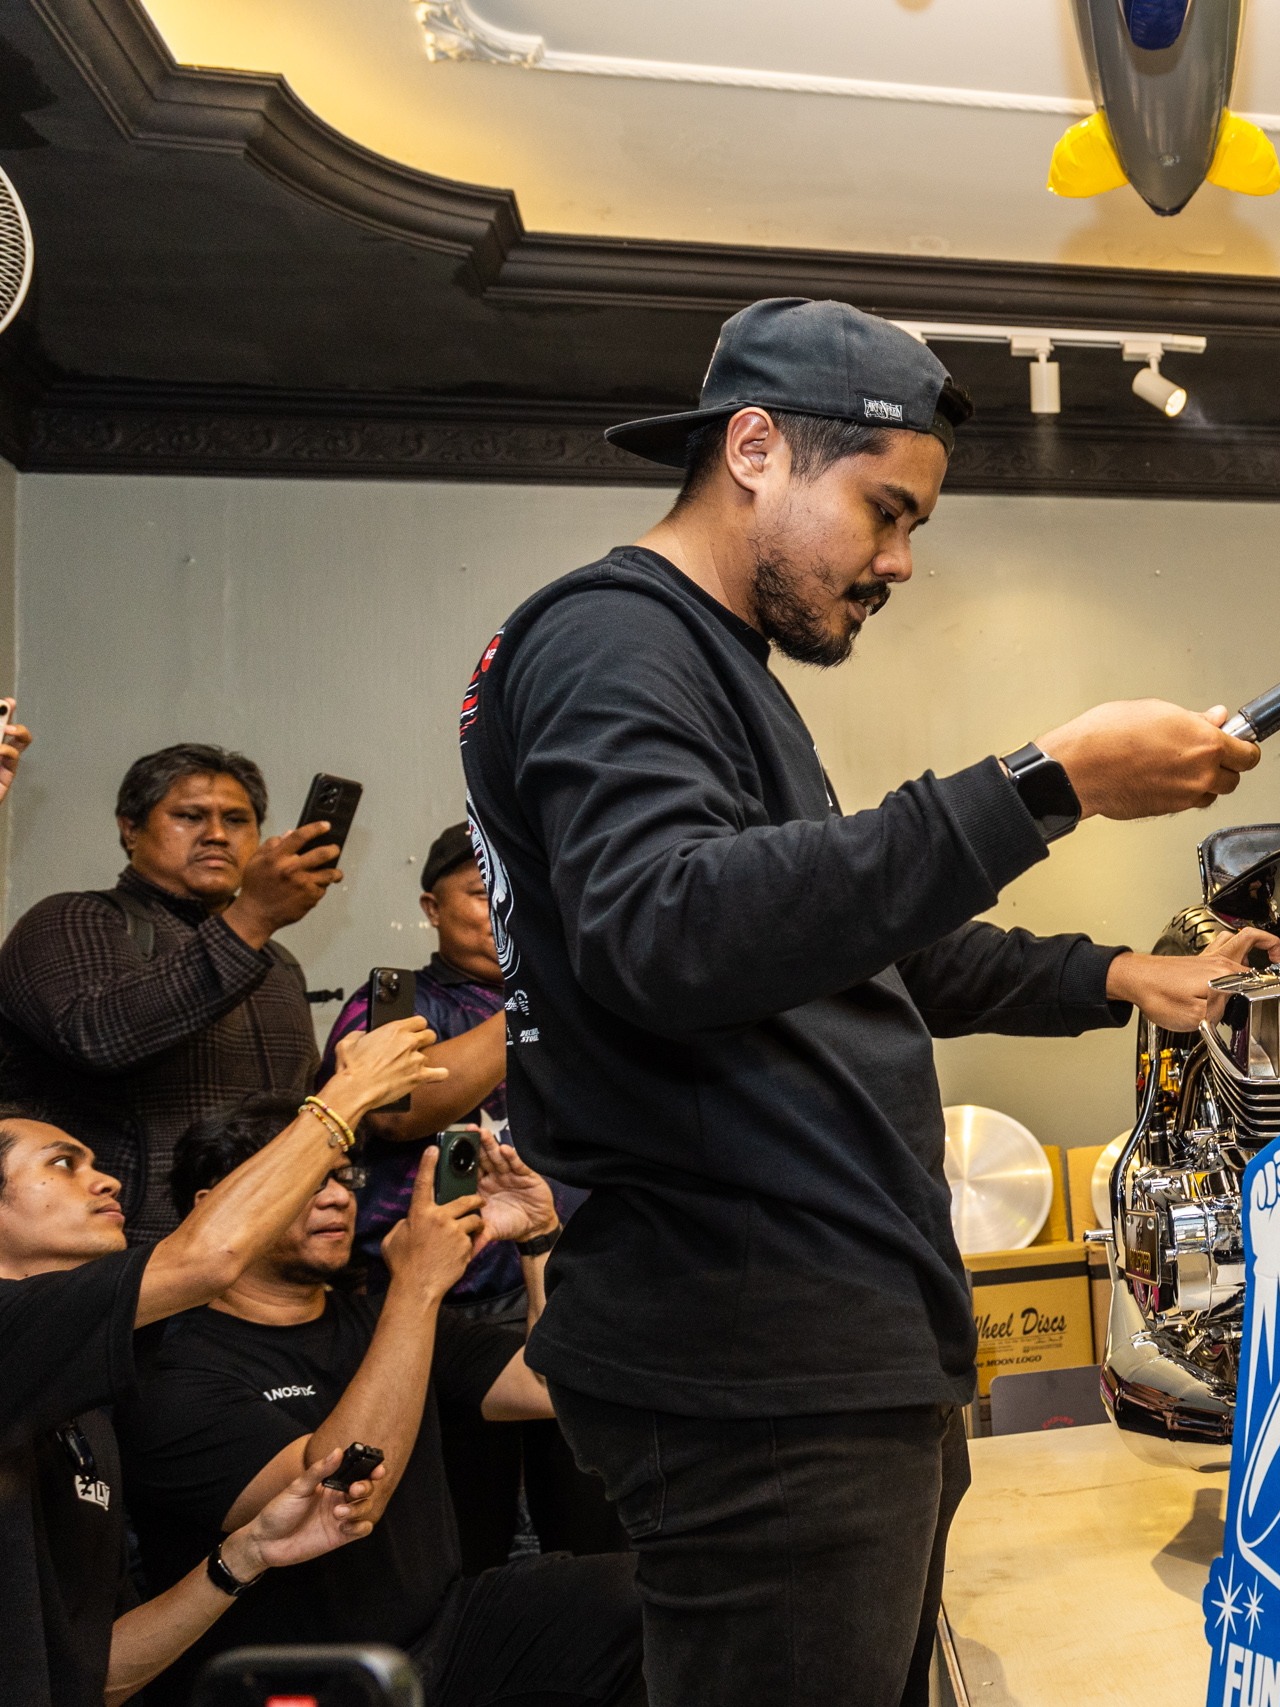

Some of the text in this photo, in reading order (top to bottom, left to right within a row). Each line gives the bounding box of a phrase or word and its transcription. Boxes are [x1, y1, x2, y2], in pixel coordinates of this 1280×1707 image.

[1021, 1307, 1067, 1336] Discs
[986, 1357, 1014, 1368] MOON
[1016, 1354, 1042, 1365] LOGO
